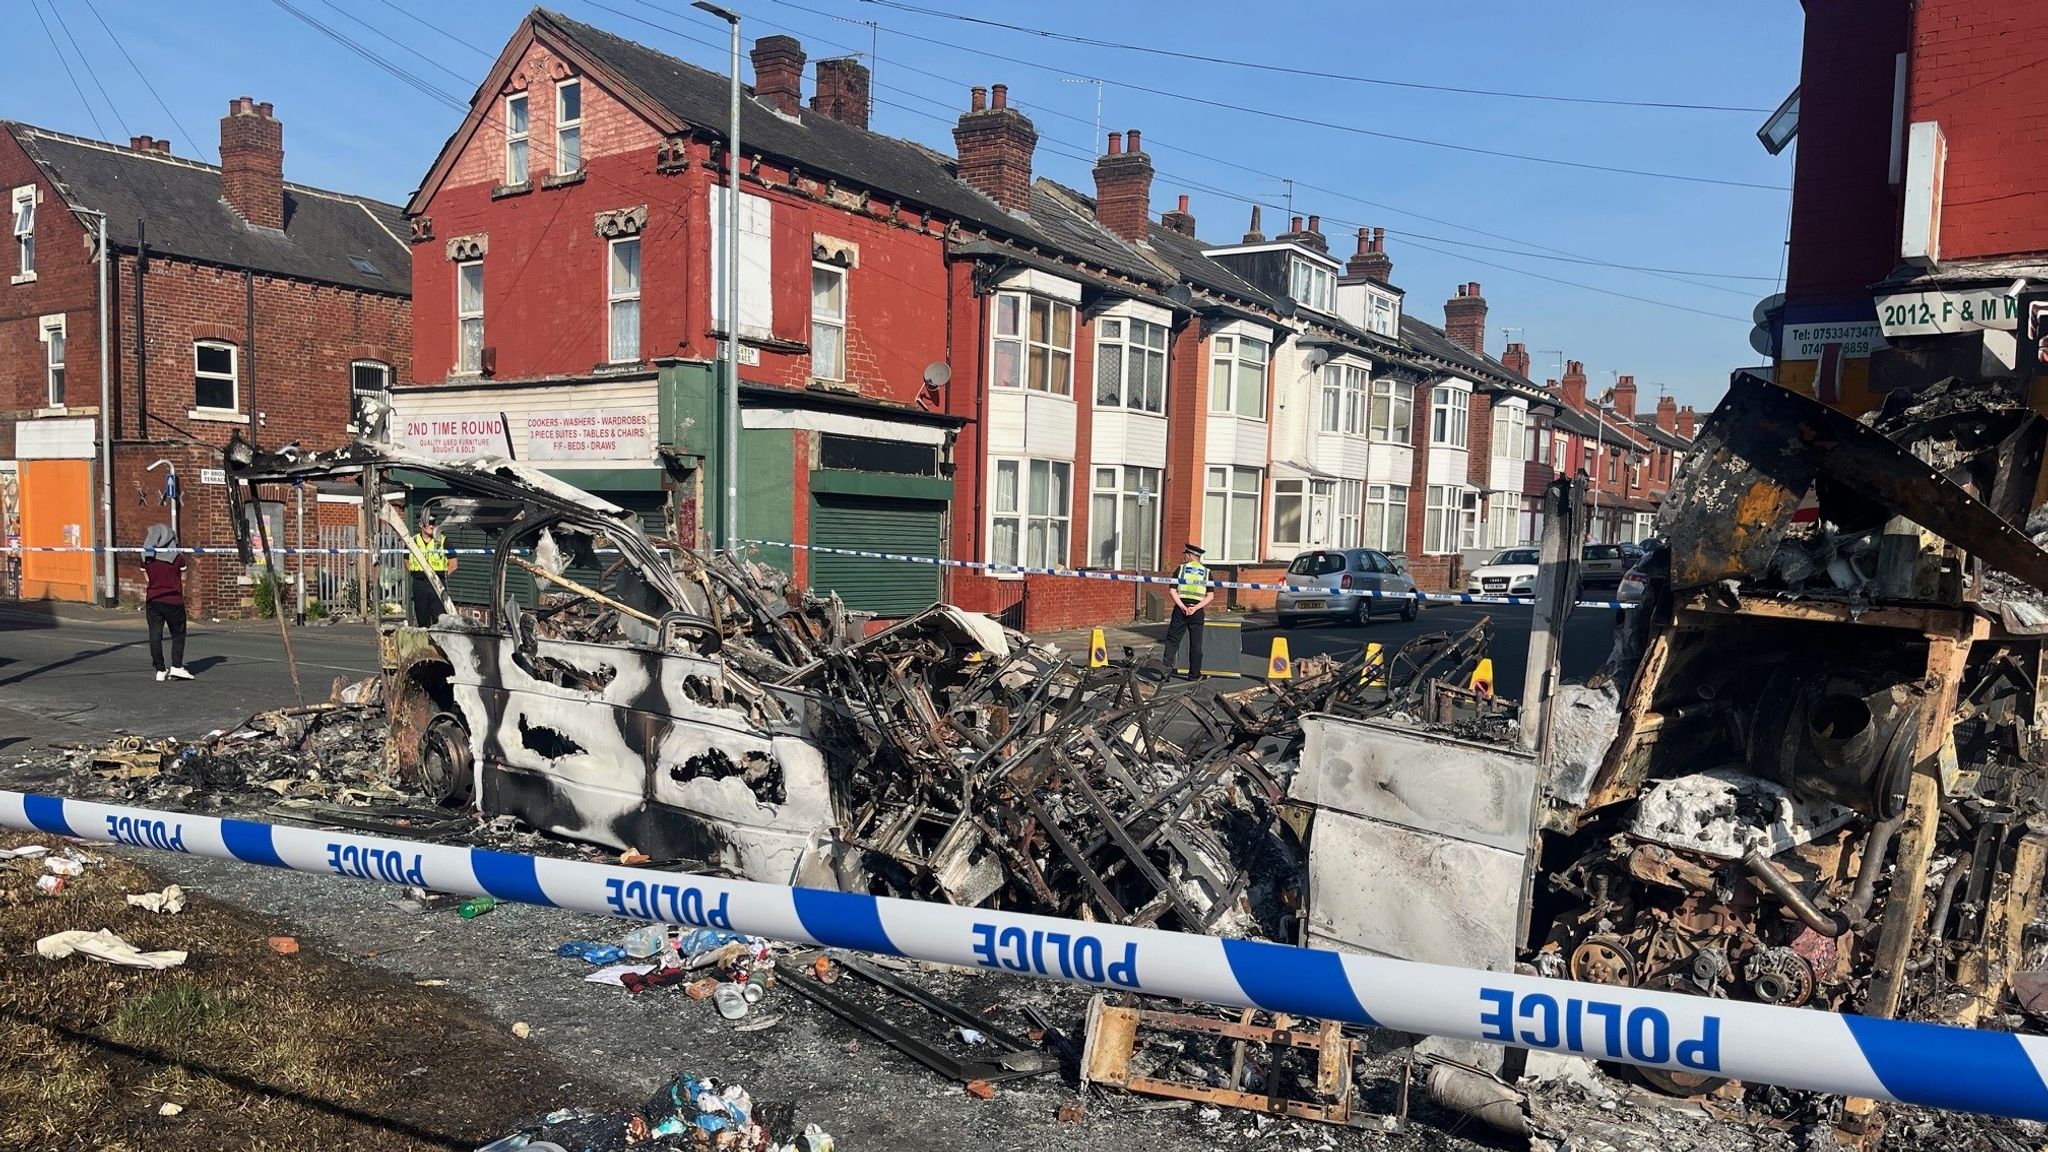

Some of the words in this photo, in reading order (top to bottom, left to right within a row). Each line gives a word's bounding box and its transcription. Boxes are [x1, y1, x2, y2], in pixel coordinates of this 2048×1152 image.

[1885, 302, 1935, 326] 2012-
[1942, 301, 1953, 322] F
[1961, 300, 1973, 321] &
[1981, 299, 1996, 321] M
[1793, 329, 1810, 340] Tel:
[1802, 342, 1869, 355] 0748859
[408, 422, 428, 436] 2ND
[432, 422, 457, 435] TIME
[462, 420, 502, 434] ROUND
[527, 418, 558, 427] COOKERS
[563, 417, 596, 426] WASHERS
[602, 416, 647, 425] WARDROBES
[535, 430, 554, 438] PIECE
[556, 430, 578, 438] SUITES
[583, 429, 609, 438] TABLES
[611, 428, 616, 438] &
[617, 428, 644, 437] CHAIRS
[568, 442, 586, 450] BEDS
[591, 441, 616, 450] DRAWS
[106, 815, 190, 853] POLICE
[326, 844, 430, 888] POLICE
[606, 878, 735, 931] POLICE
[972, 923, 1141, 988] POLICE
[1480, 987, 1721, 1072] POLICE
